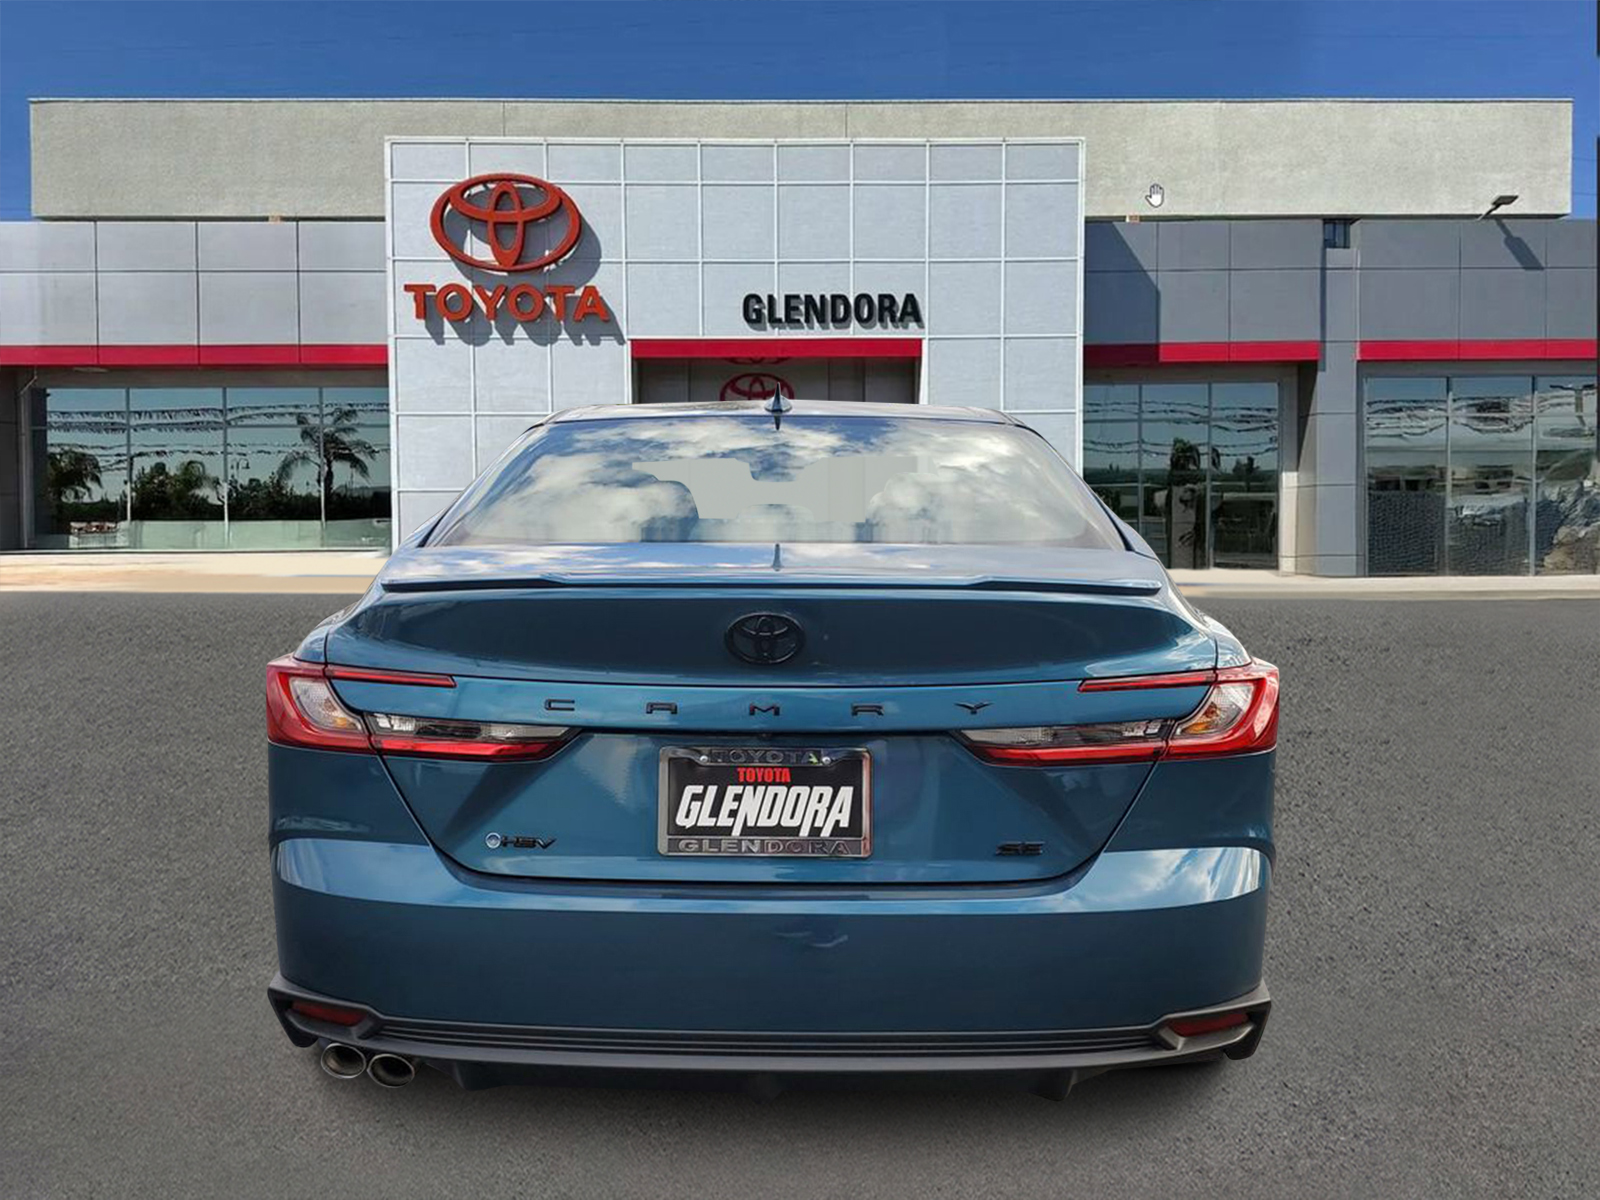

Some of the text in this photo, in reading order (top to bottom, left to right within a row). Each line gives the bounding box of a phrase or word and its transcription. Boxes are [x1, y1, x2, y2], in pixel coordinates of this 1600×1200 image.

[403, 283, 610, 322] TOYOTA
[742, 293, 923, 326] GLENDORA
[710, 750, 820, 764] TOYOTA
[737, 767, 791, 783] TOYOTA
[675, 785, 854, 837] GLENDORA
[678, 839, 850, 854] GLENDORA
[995, 842, 1043, 856] SE
